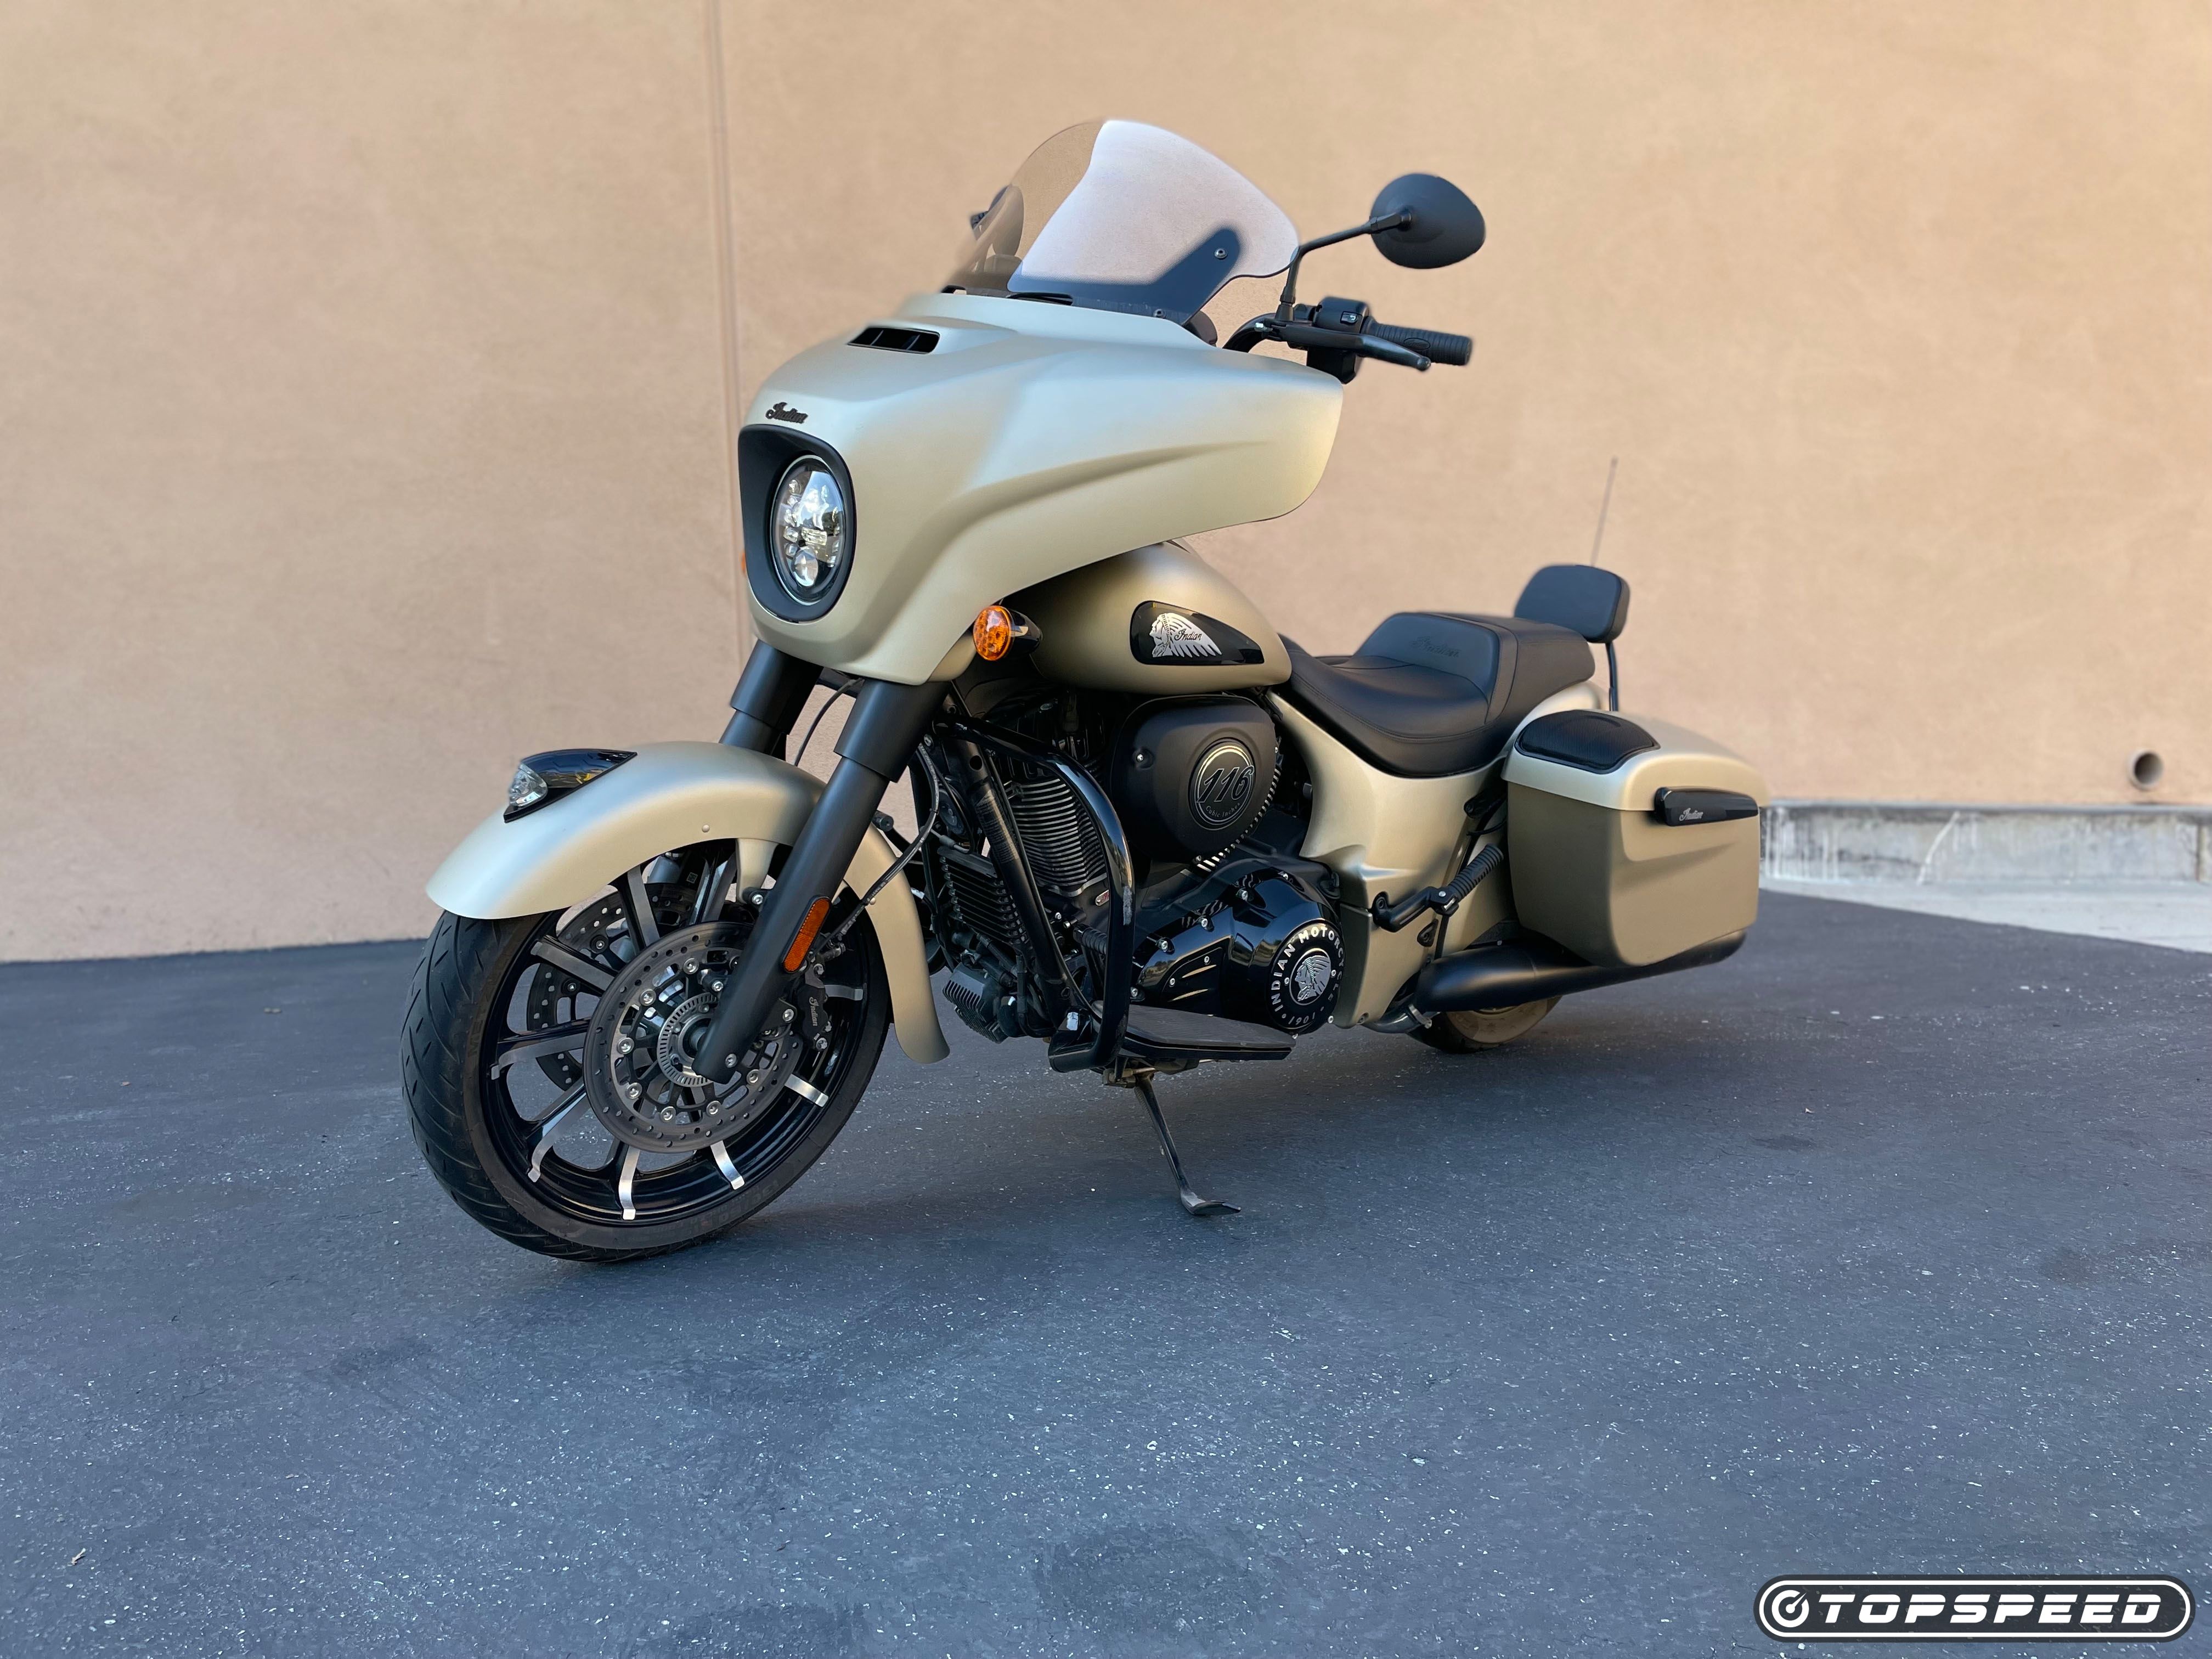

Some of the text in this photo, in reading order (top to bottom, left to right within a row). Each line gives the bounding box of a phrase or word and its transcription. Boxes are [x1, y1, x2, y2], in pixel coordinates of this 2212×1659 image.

[1174, 628, 1203, 641] Indian
[1196, 765, 1255, 803] 116
[1206, 805, 1221, 817] Cubic
[1679, 808, 1703, 821] Indian
[1271, 926, 1344, 1012] INDIAN MOTORCYCLE
[809, 996, 820, 1026] Indian
[1288, 1012, 1316, 1025] 1901
